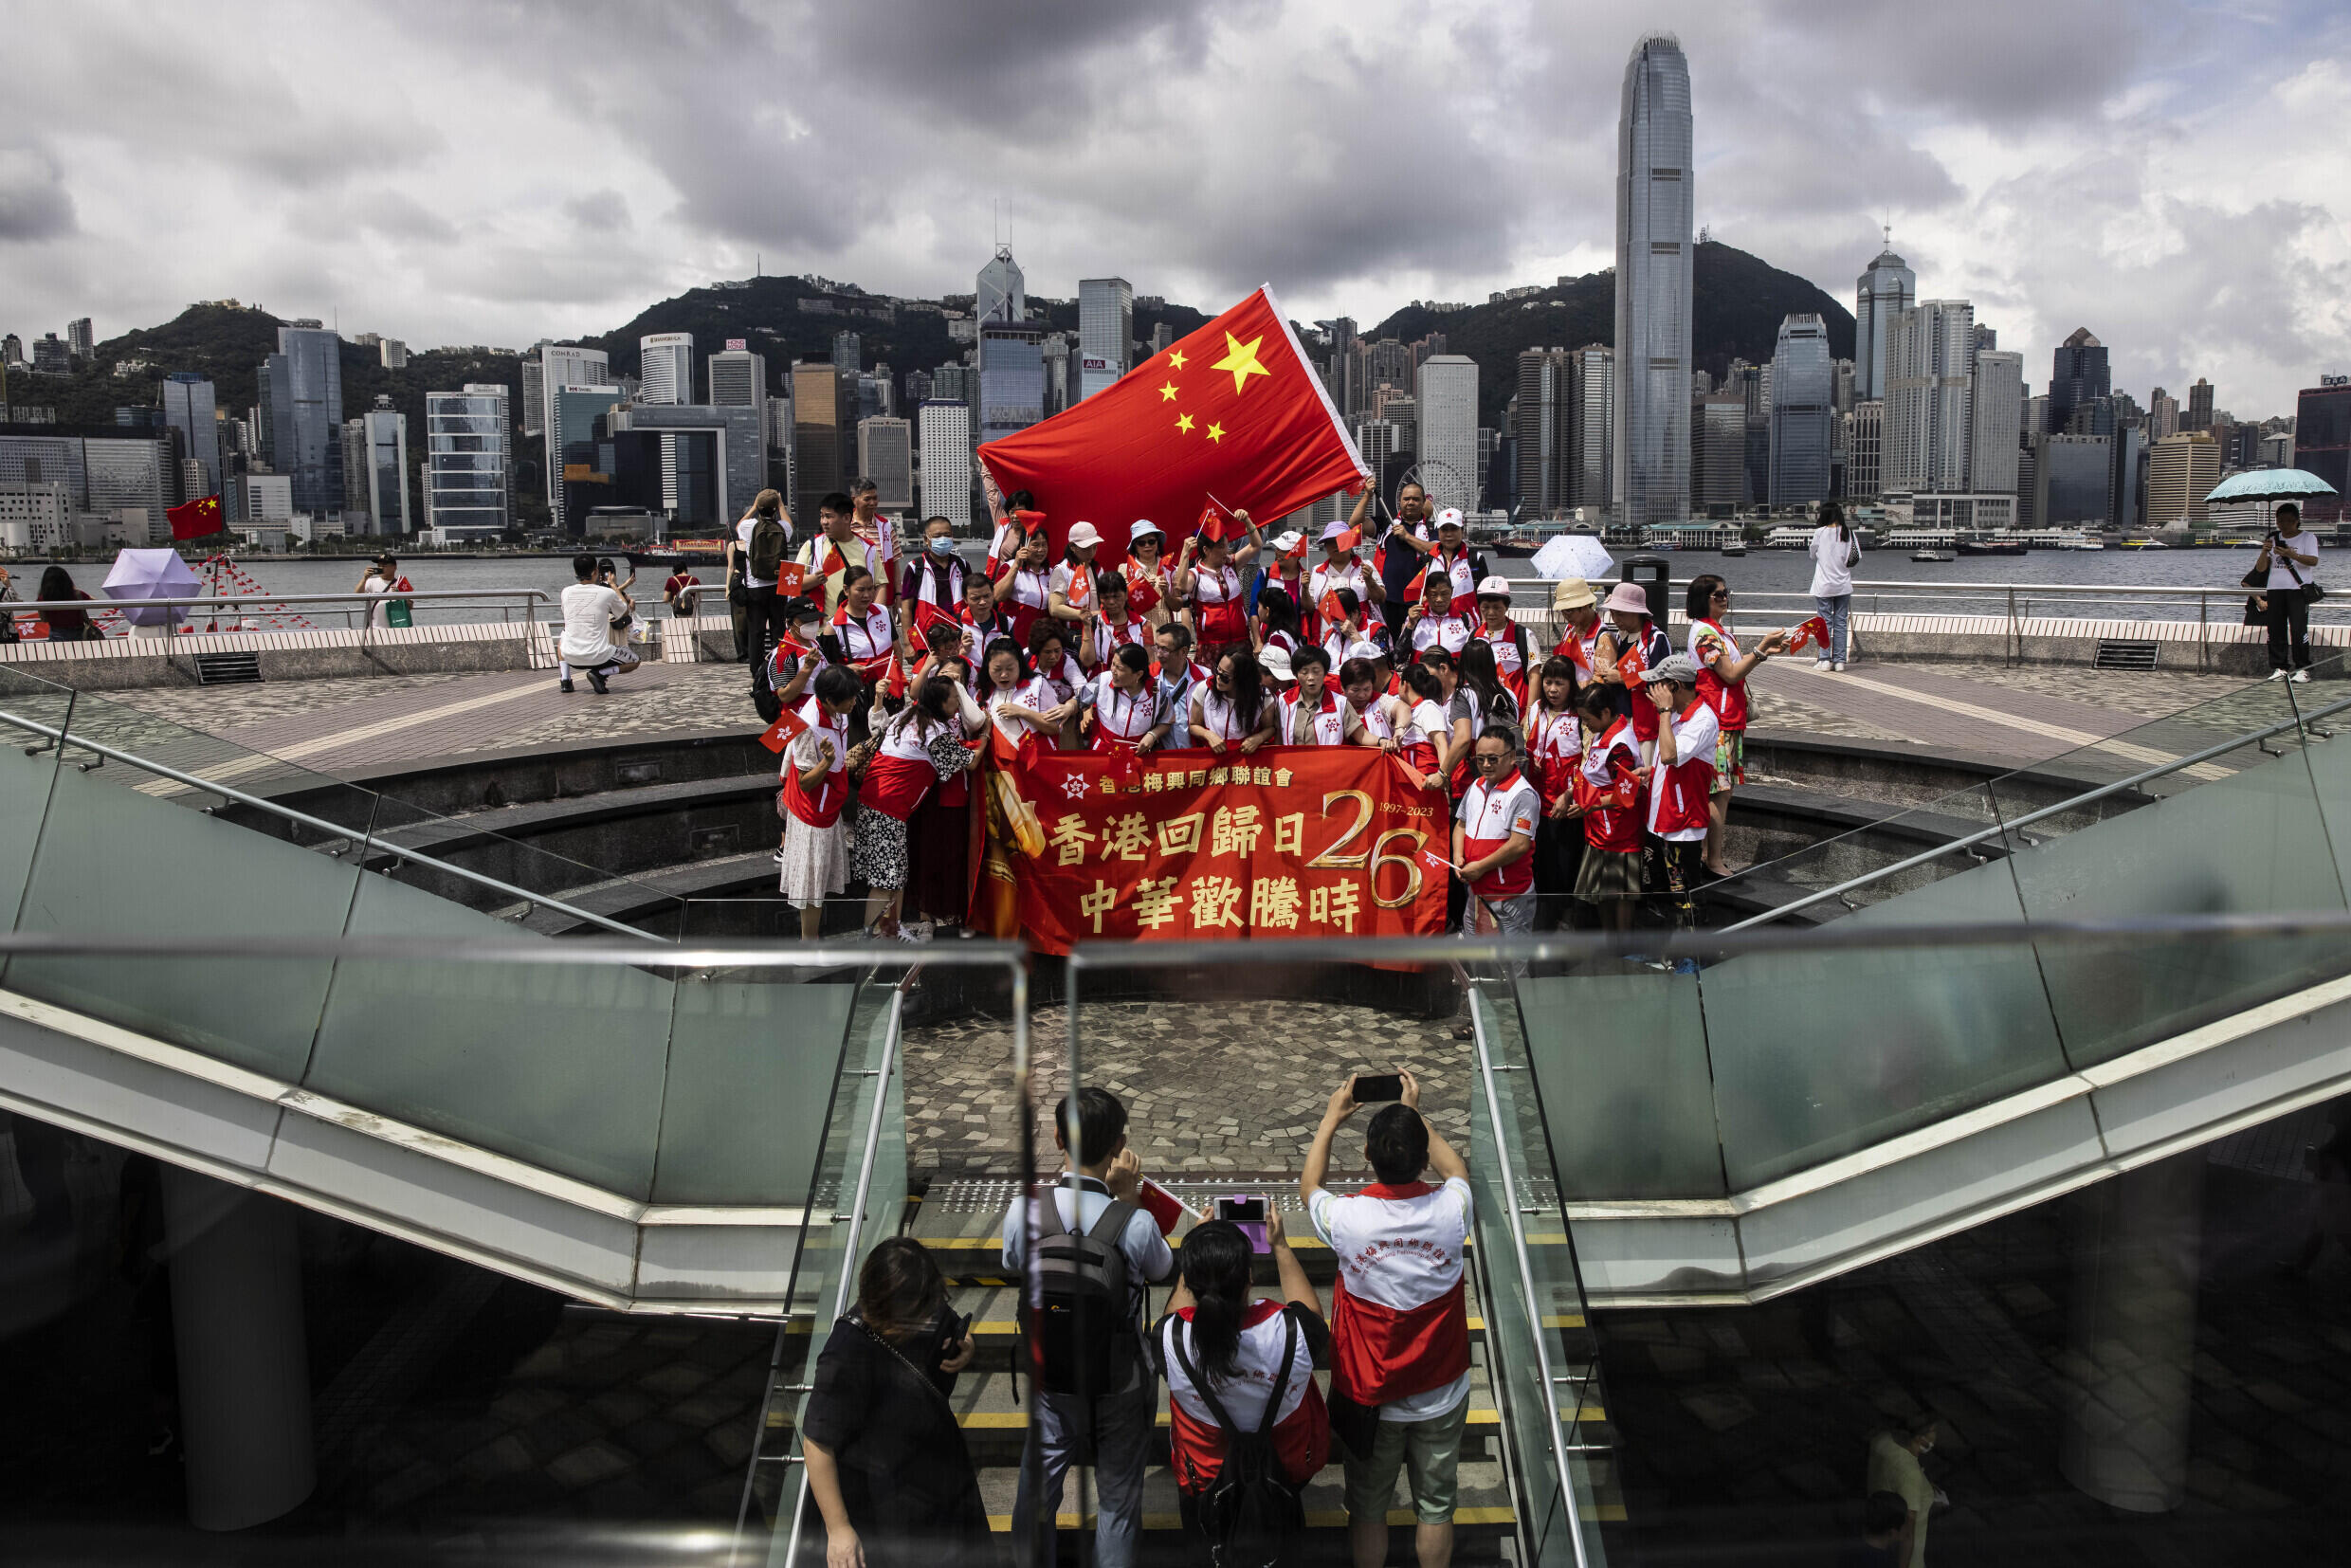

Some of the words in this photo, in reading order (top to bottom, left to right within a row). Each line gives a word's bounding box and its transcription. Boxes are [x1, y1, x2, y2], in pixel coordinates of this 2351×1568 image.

[1049, 804, 1304, 866] 香港回歸日
[1305, 790, 1430, 909] 26
[1080, 875, 1360, 934] 中華歡騰時
